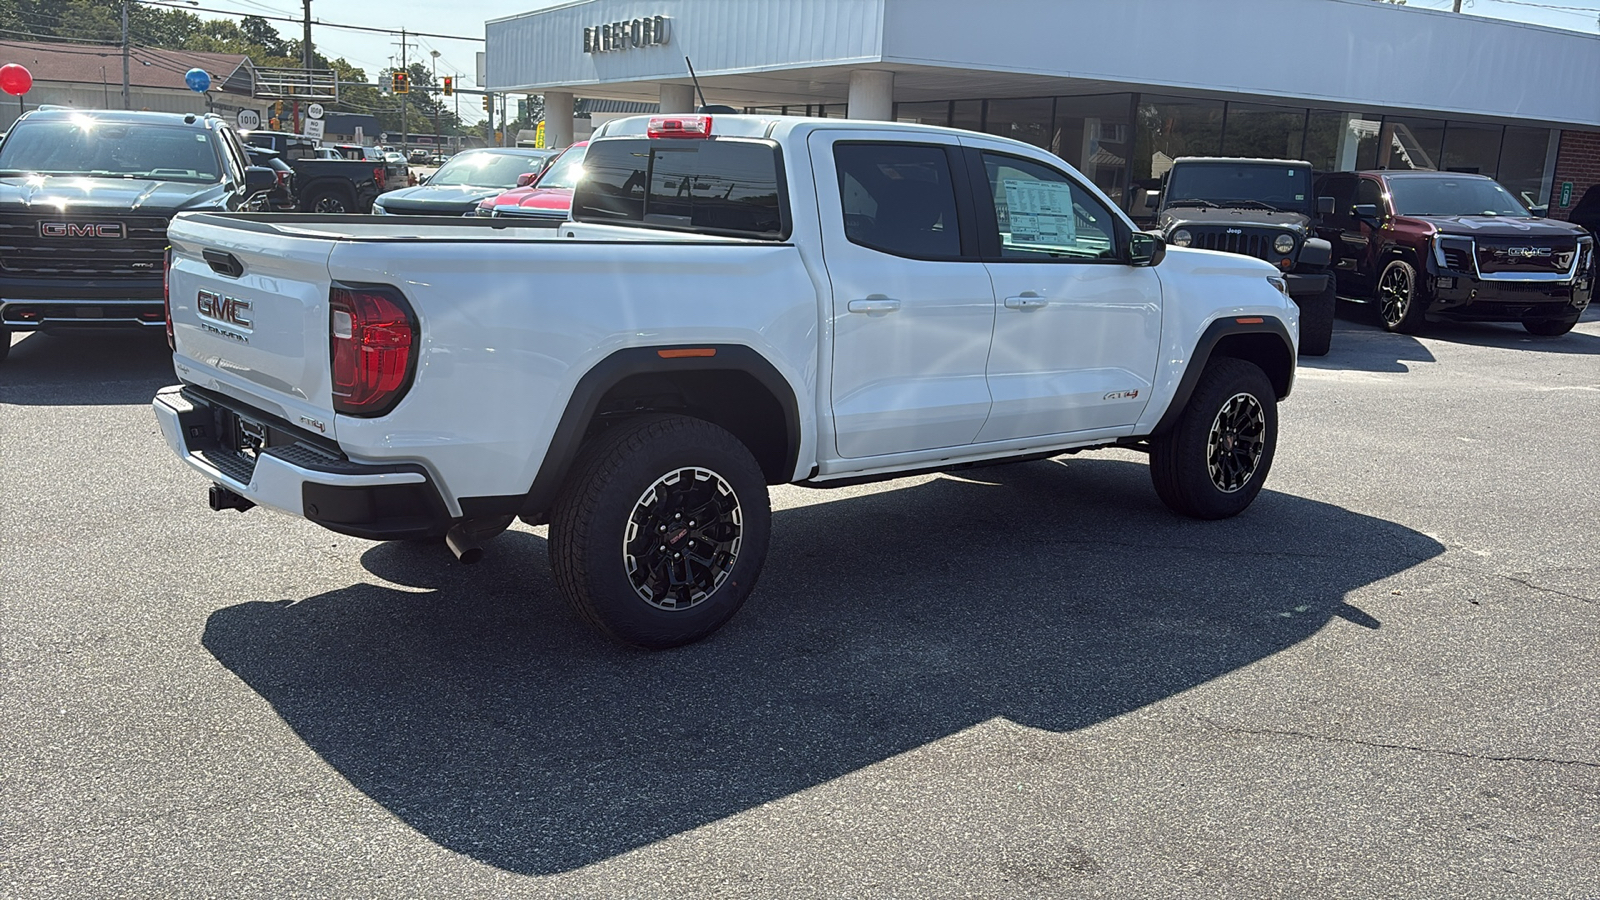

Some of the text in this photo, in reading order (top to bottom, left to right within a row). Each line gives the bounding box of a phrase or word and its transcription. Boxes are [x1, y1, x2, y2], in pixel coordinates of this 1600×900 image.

[583, 15, 672, 53] BAREFORD
[240, 116, 256, 125] 1010
[42, 222, 121, 238] GMC
[1226, 227, 1242, 235] Jeep
[1508, 247, 1552, 258] GMC
[197, 288, 254, 334] GMC
[201, 322, 250, 344] CANYON
[1103, 388, 1139, 400] AT4
